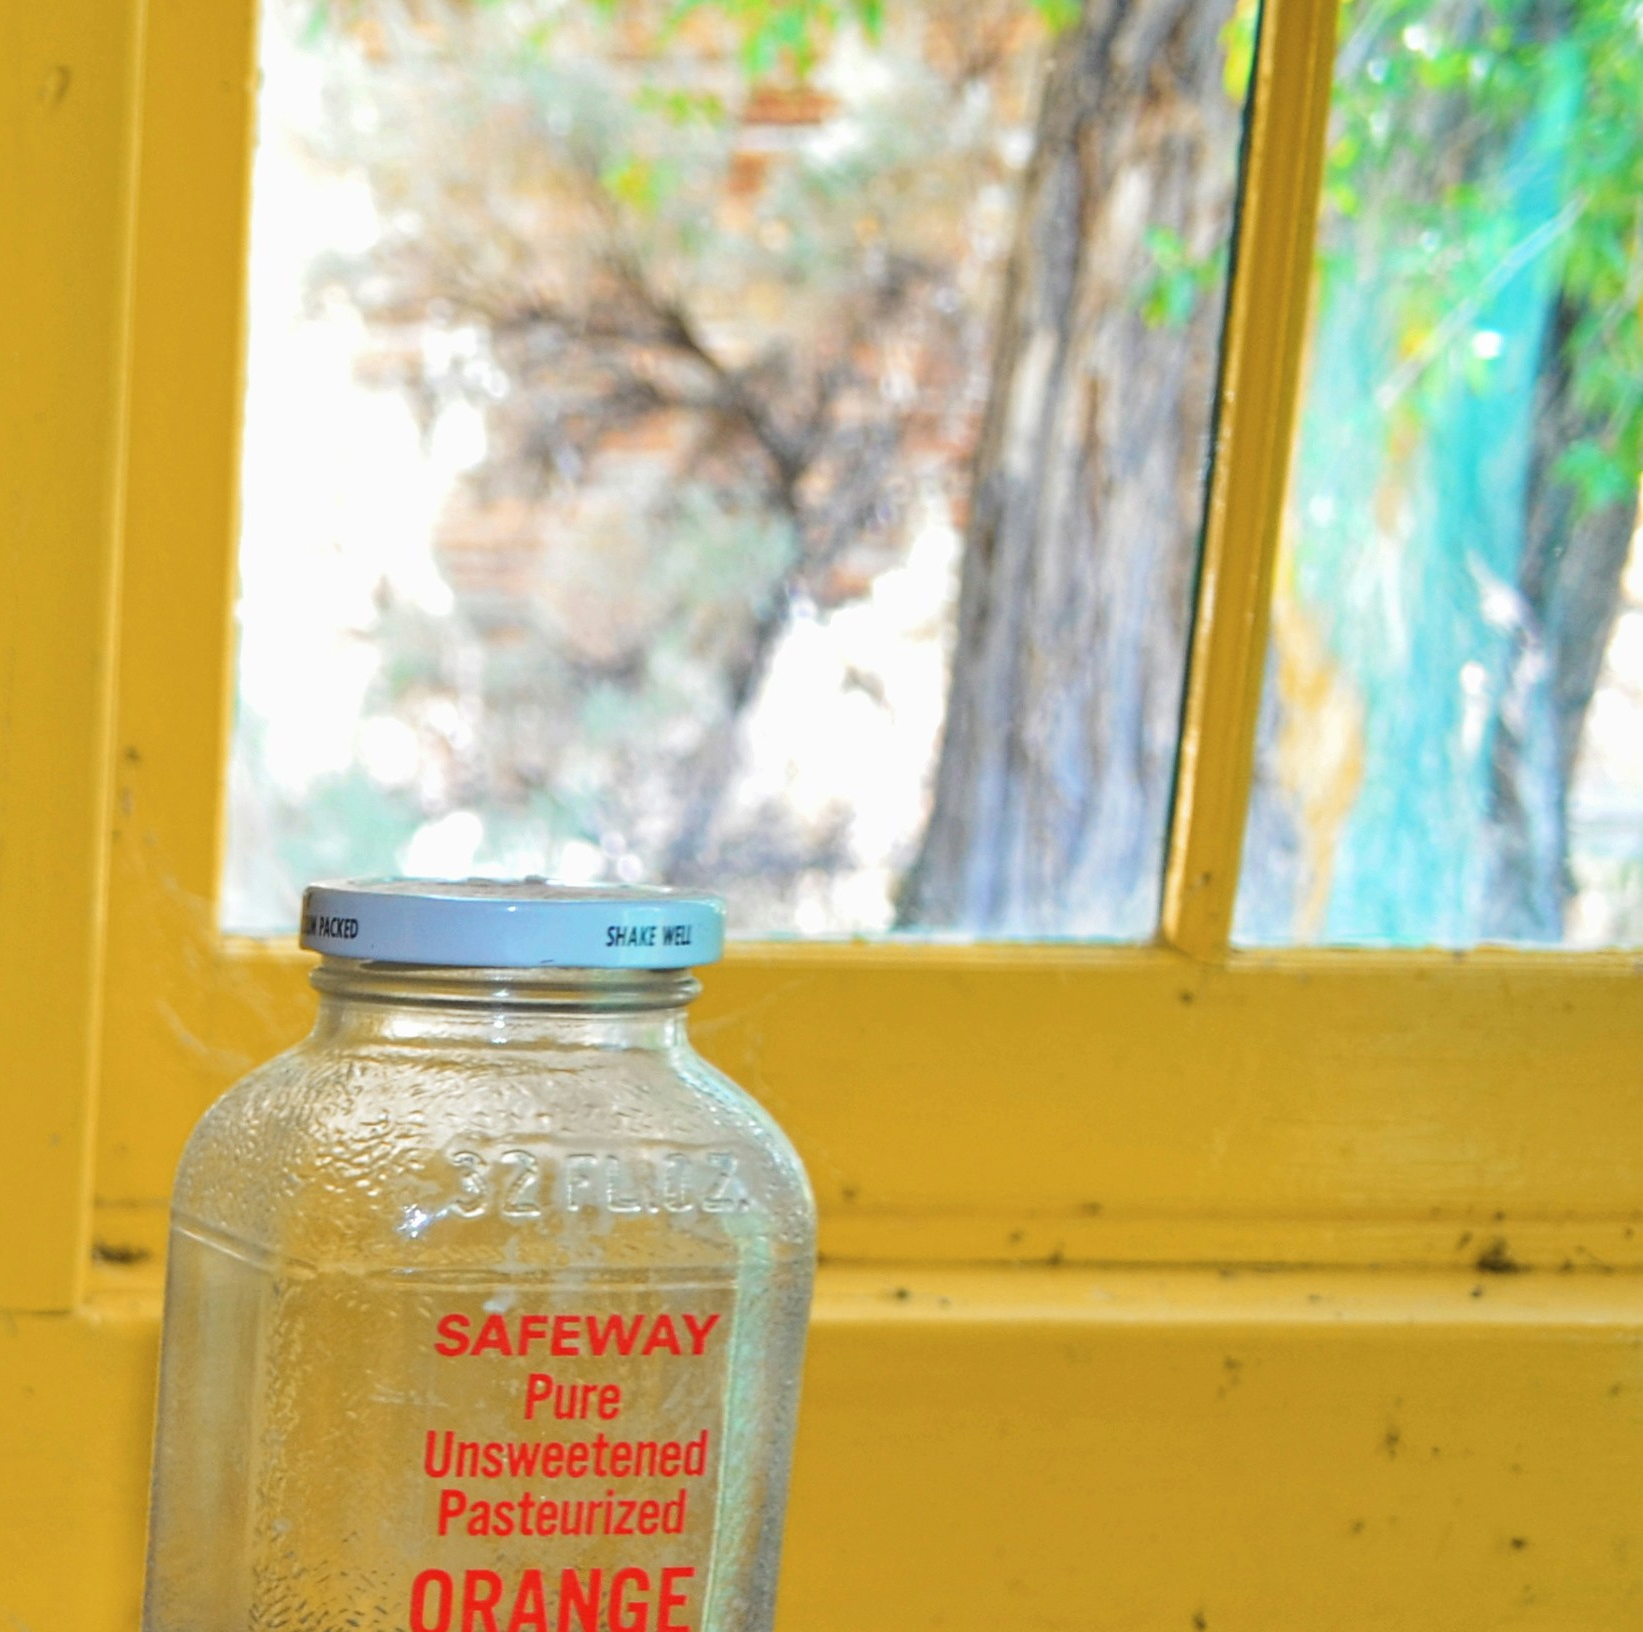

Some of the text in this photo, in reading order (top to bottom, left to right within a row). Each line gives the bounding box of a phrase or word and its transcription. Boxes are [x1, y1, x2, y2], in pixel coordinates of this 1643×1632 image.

[318, 915, 359, 939] PACKED
[605, 923, 692, 947] SHAKE WELL
[451, 1149, 542, 1217] 32
[433, 1313, 721, 1358] SAFEWAY
[524, 1372, 622, 1421] Pure
[423, 1429, 709, 1479] Unsweetened
[436, 1488, 688, 1538] Pasteurized
